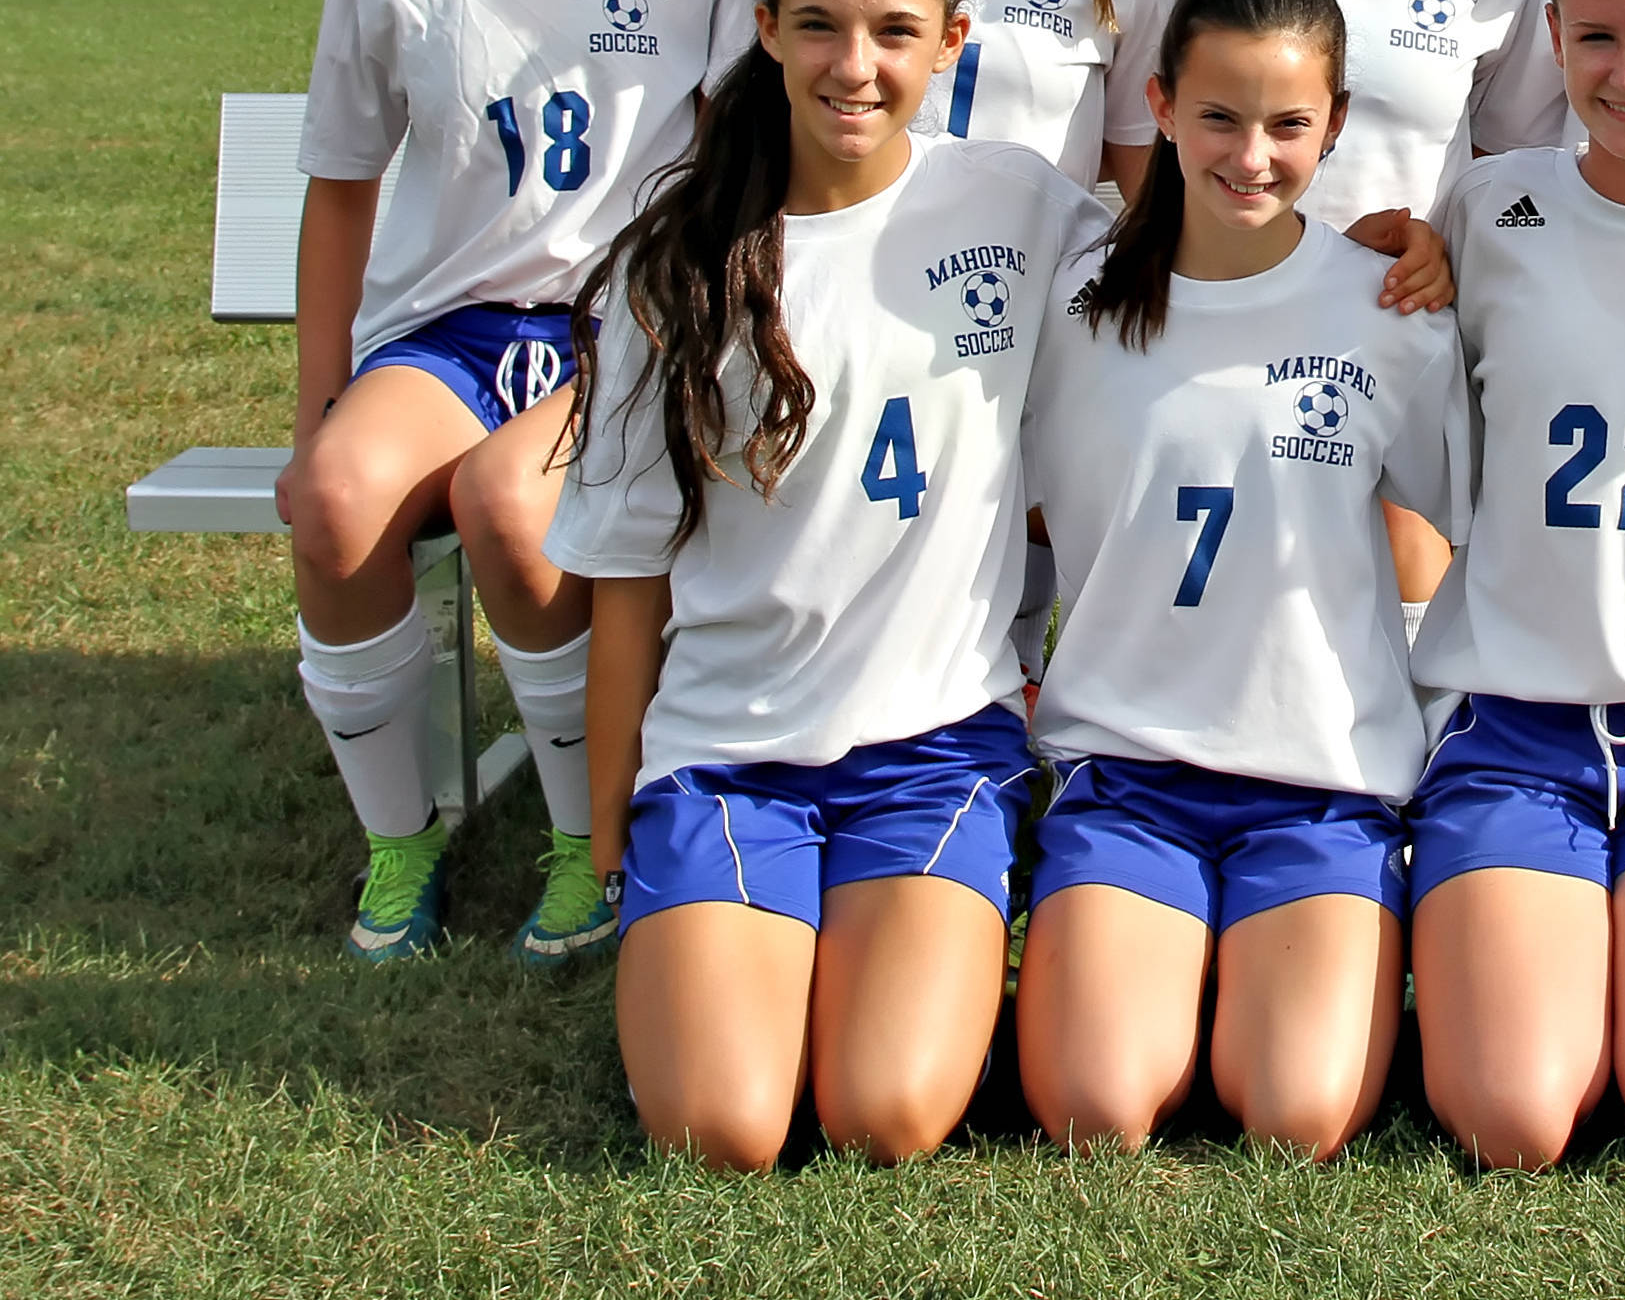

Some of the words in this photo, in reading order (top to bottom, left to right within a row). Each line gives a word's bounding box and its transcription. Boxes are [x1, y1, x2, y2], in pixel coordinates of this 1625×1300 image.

[1003, 6, 1073, 38] SOCCER
[589, 33, 660, 55] SOCCER
[1390, 29, 1460, 58] SOCCER
[486, 91, 592, 197] 18
[1495, 215, 1545, 228] adidas
[925, 245, 1026, 291] MAHOPAC
[954, 326, 1015, 358] SOCCER
[1265, 356, 1377, 401] MAHOPAC
[860, 396, 927, 521] 4
[1271, 436, 1354, 467] SOCCER
[1173, 486, 1234, 607] 7
